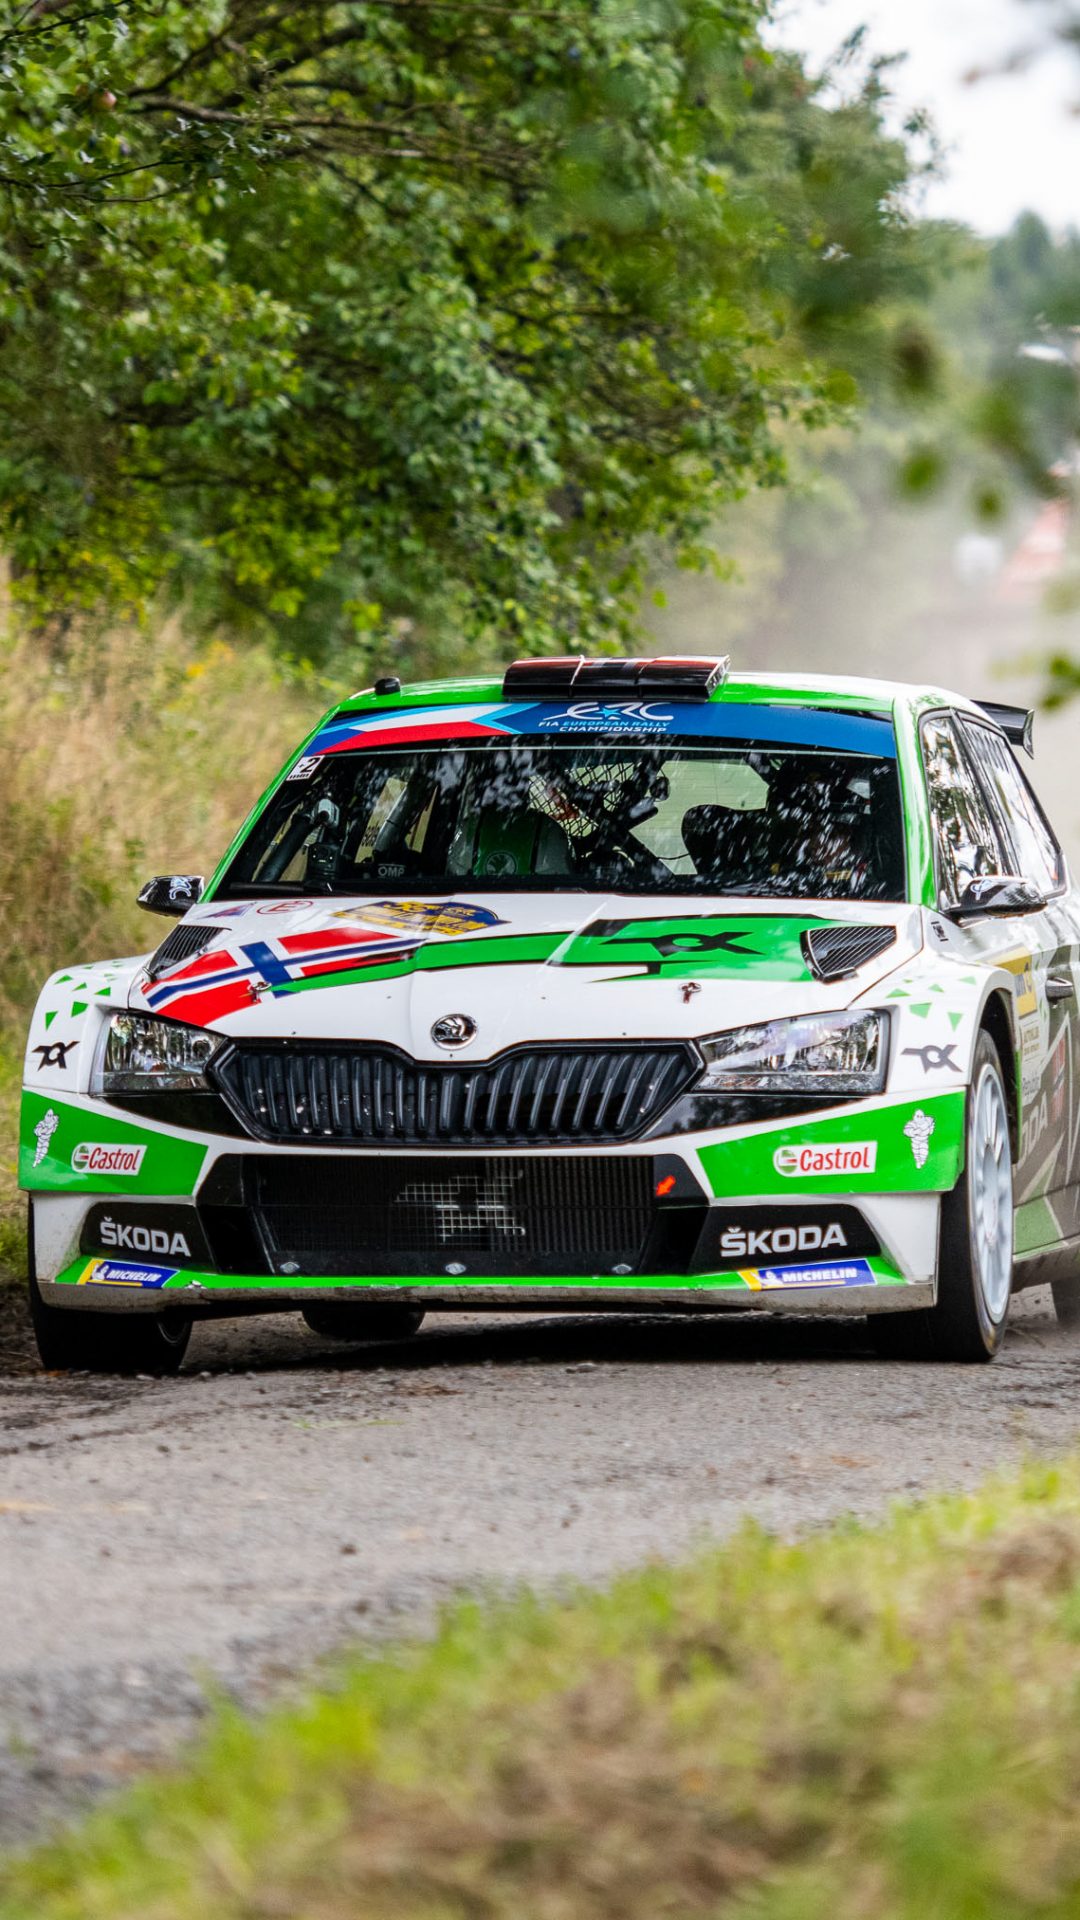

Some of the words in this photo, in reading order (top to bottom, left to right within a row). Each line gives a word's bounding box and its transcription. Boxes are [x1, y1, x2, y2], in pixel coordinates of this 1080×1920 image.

[378, 866, 405, 877] OMP
[89, 1147, 140, 1170] Castrol
[800, 1146, 870, 1172] Castrol
[100, 1216, 191, 1257] ŠKODA
[720, 1224, 847, 1257] ŠKODA
[106, 1269, 162, 1282] MICHELIN
[781, 1267, 857, 1283] MICHELIN
